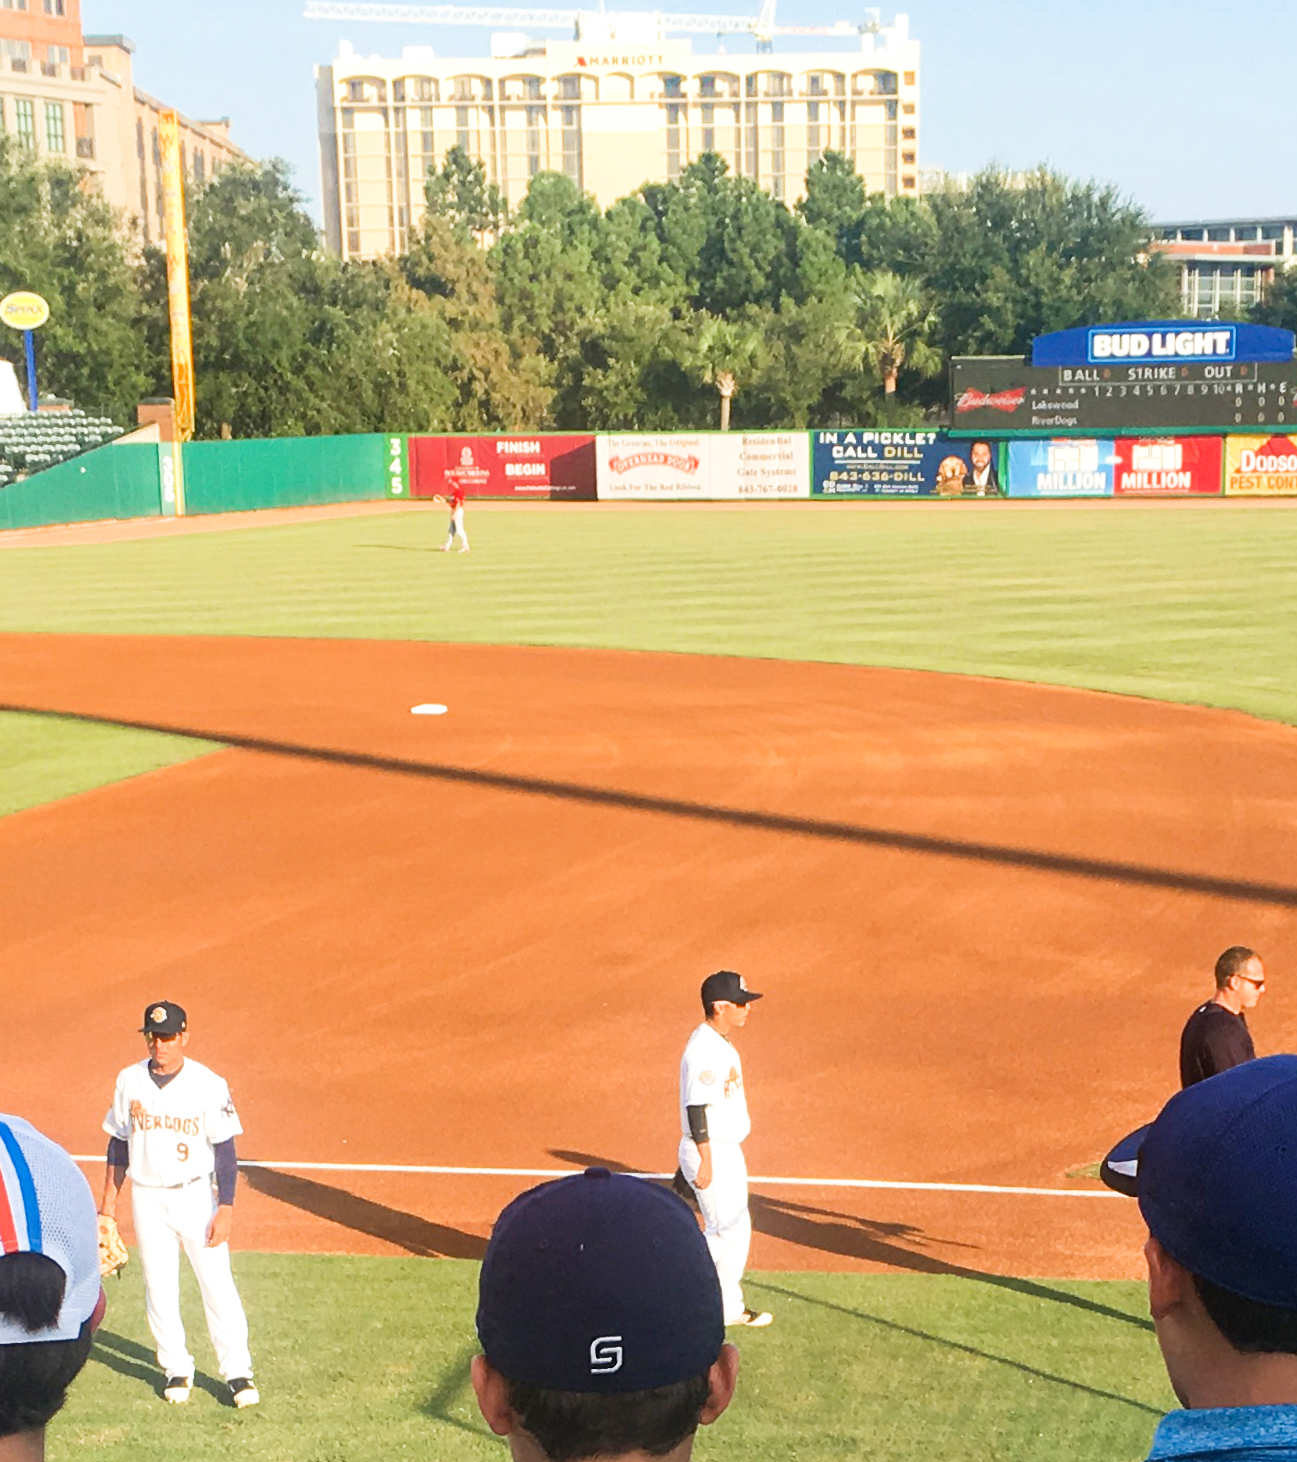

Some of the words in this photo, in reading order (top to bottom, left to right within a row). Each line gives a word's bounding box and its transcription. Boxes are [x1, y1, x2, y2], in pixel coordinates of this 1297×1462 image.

[589, 55, 663, 65] MARRIOTT
[1092, 333, 1150, 358] BUD
[1151, 331, 1230, 356] LIGHT
[1062, 368, 1100, 382] BALL
[1127, 367, 1176, 381] STRIKE
[1204, 365, 1234, 379] OUT
[1105, 386, 1113, 397] 2
[1031, 415, 1078, 427] RiverDogs
[819, 432, 837, 444] IN
[843, 432, 857, 444] A
[862, 431, 937, 445] PICKLE?
[496, 440, 541, 454] FINISH
[831, 446, 878, 459] CALL
[883, 446, 924, 459] DILL
[504, 462, 546, 477] BEGIN
[1036, 471, 1107, 490] MILLION
[1120, 471, 1192, 489] MILLION
[1229, 473, 1263, 489] PEST
[176, 1142, 190, 1163] 9
